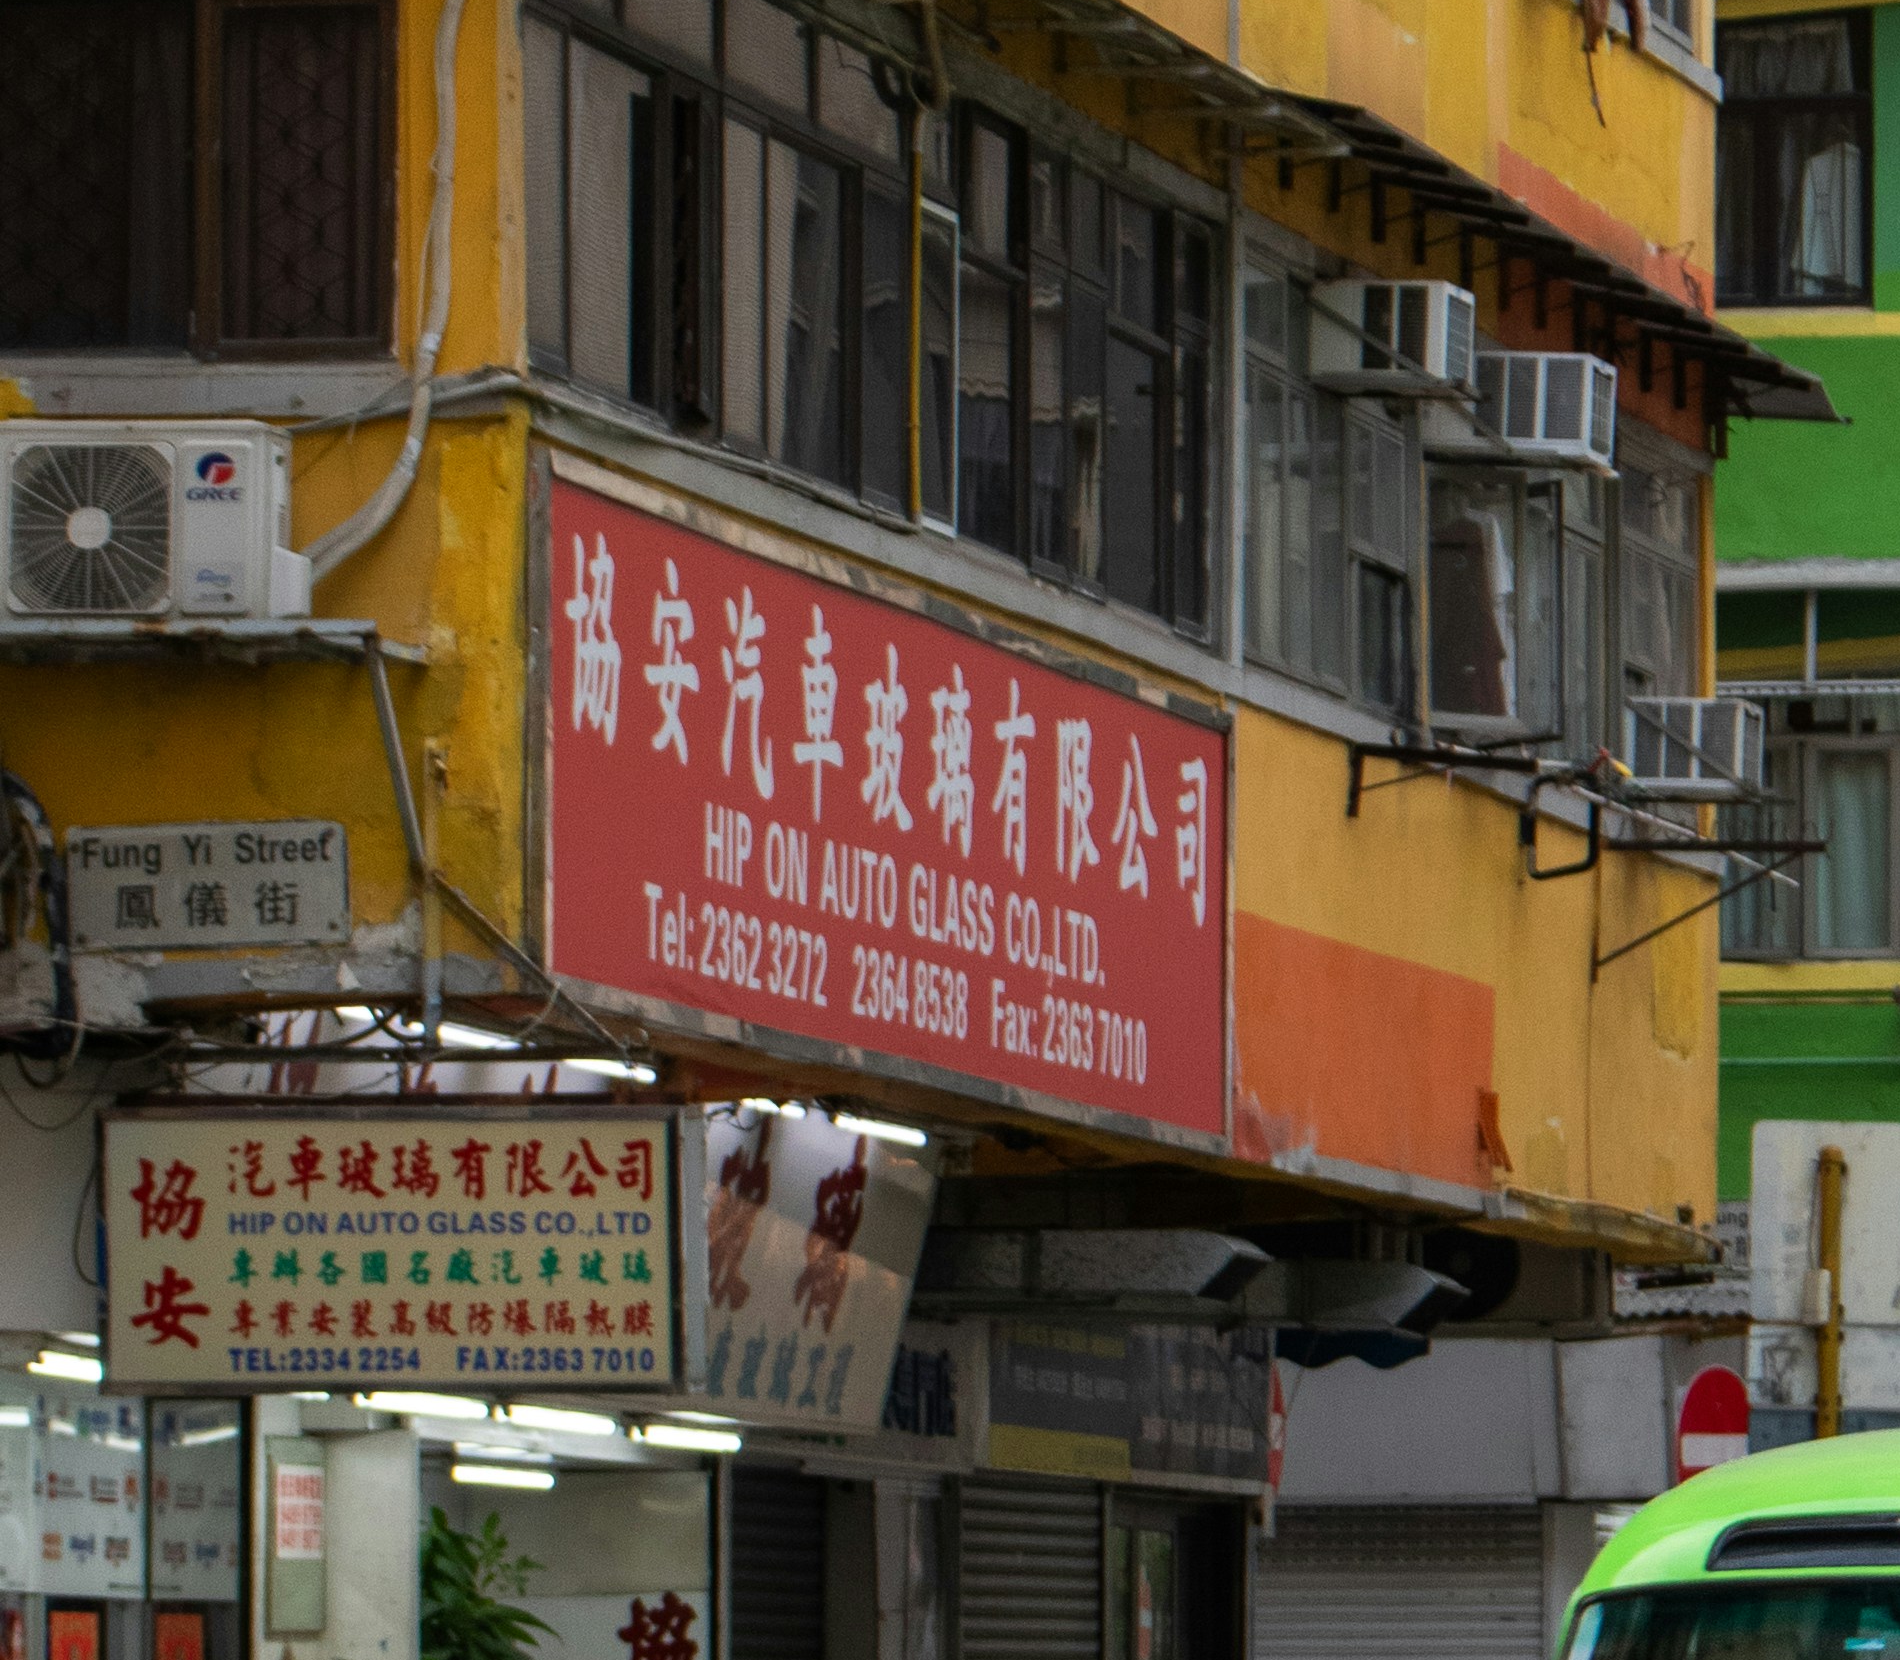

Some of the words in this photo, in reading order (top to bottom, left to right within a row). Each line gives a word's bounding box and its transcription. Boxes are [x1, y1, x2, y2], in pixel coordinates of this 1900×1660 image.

[565, 531, 1208, 927] 協安汽車玻璃有限公司
[80, 838, 162, 875] Fung
[182, 833, 212, 865] Yi
[234, 828, 336, 865] Street
[115, 879, 300, 930] 鳳儀街
[703, 800, 753, 888] HIP
[765, 820, 808, 906] ON
[819, 838, 898, 929] AUTO
[908, 862, 996, 957] GLASS
[1005, 891, 1106, 988] CO.,LTD.
[644, 880, 694, 972] Tel:
[700, 901, 762, 990] 2362
[767, 921, 828, 1007] 3272
[852, 944, 909, 1025] 2364
[913, 958, 969, 1040] 8538
[991, 977, 1038, 1059] Fax:
[1042, 993, 1094, 1071] 2363
[1097, 1007, 1148, 1085] 7010
[227, 1135, 653, 1202] 汽車玻璃有限公司
[131, 1157, 211, 1349] 協安
[227, 1211, 277, 1236] HIP
[282, 1210, 328, 1236] ON
[334, 1210, 421, 1236] AUTO
[426, 1210, 528, 1236] GLASS
[532, 1210, 652, 1238] CO.,LTD
[358, 1347, 421, 1372] 2254
[591, 1347, 655, 1373] 7010
